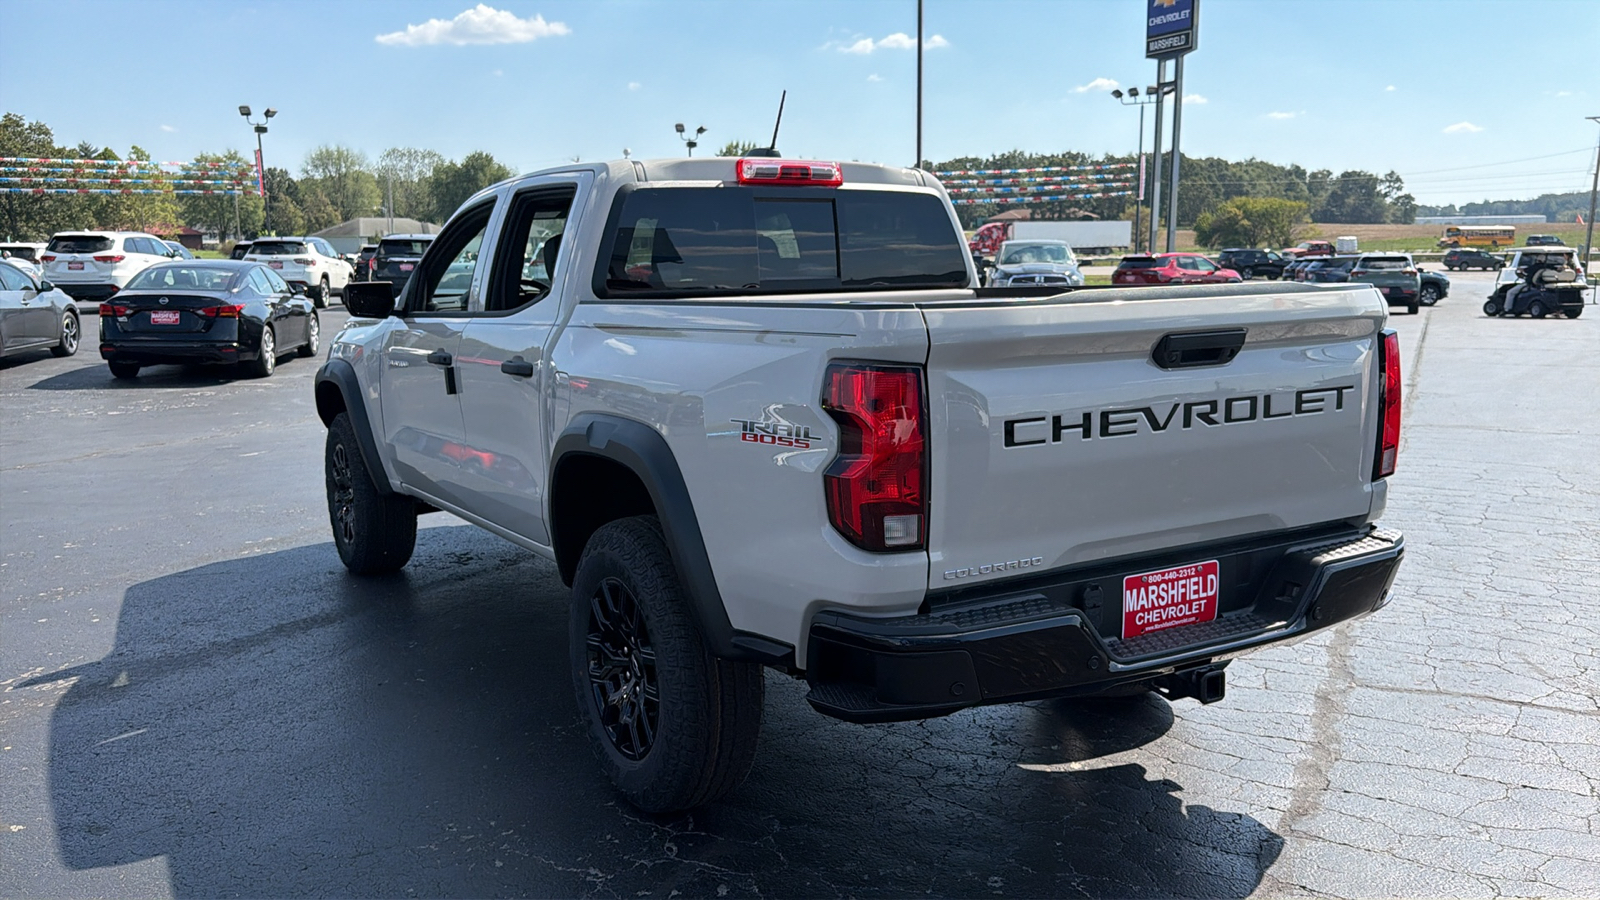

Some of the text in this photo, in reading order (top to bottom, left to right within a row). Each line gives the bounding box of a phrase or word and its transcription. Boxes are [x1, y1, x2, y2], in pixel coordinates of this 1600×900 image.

[1148, 9, 1190, 26] CHEVROLET
[1149, 35, 1185, 51] MARSHFIELD
[1004, 385, 1354, 448] CHEVROLET
[730, 419, 822, 441] TRAIL
[741, 432, 810, 449] BOSS
[944, 556, 1042, 580] COLORADO
[1148, 567, 1195, 583] 800-440-2312
[1125, 574, 1217, 613] MARSHFIELD
[1135, 600, 1207, 625] CHEVROLET
